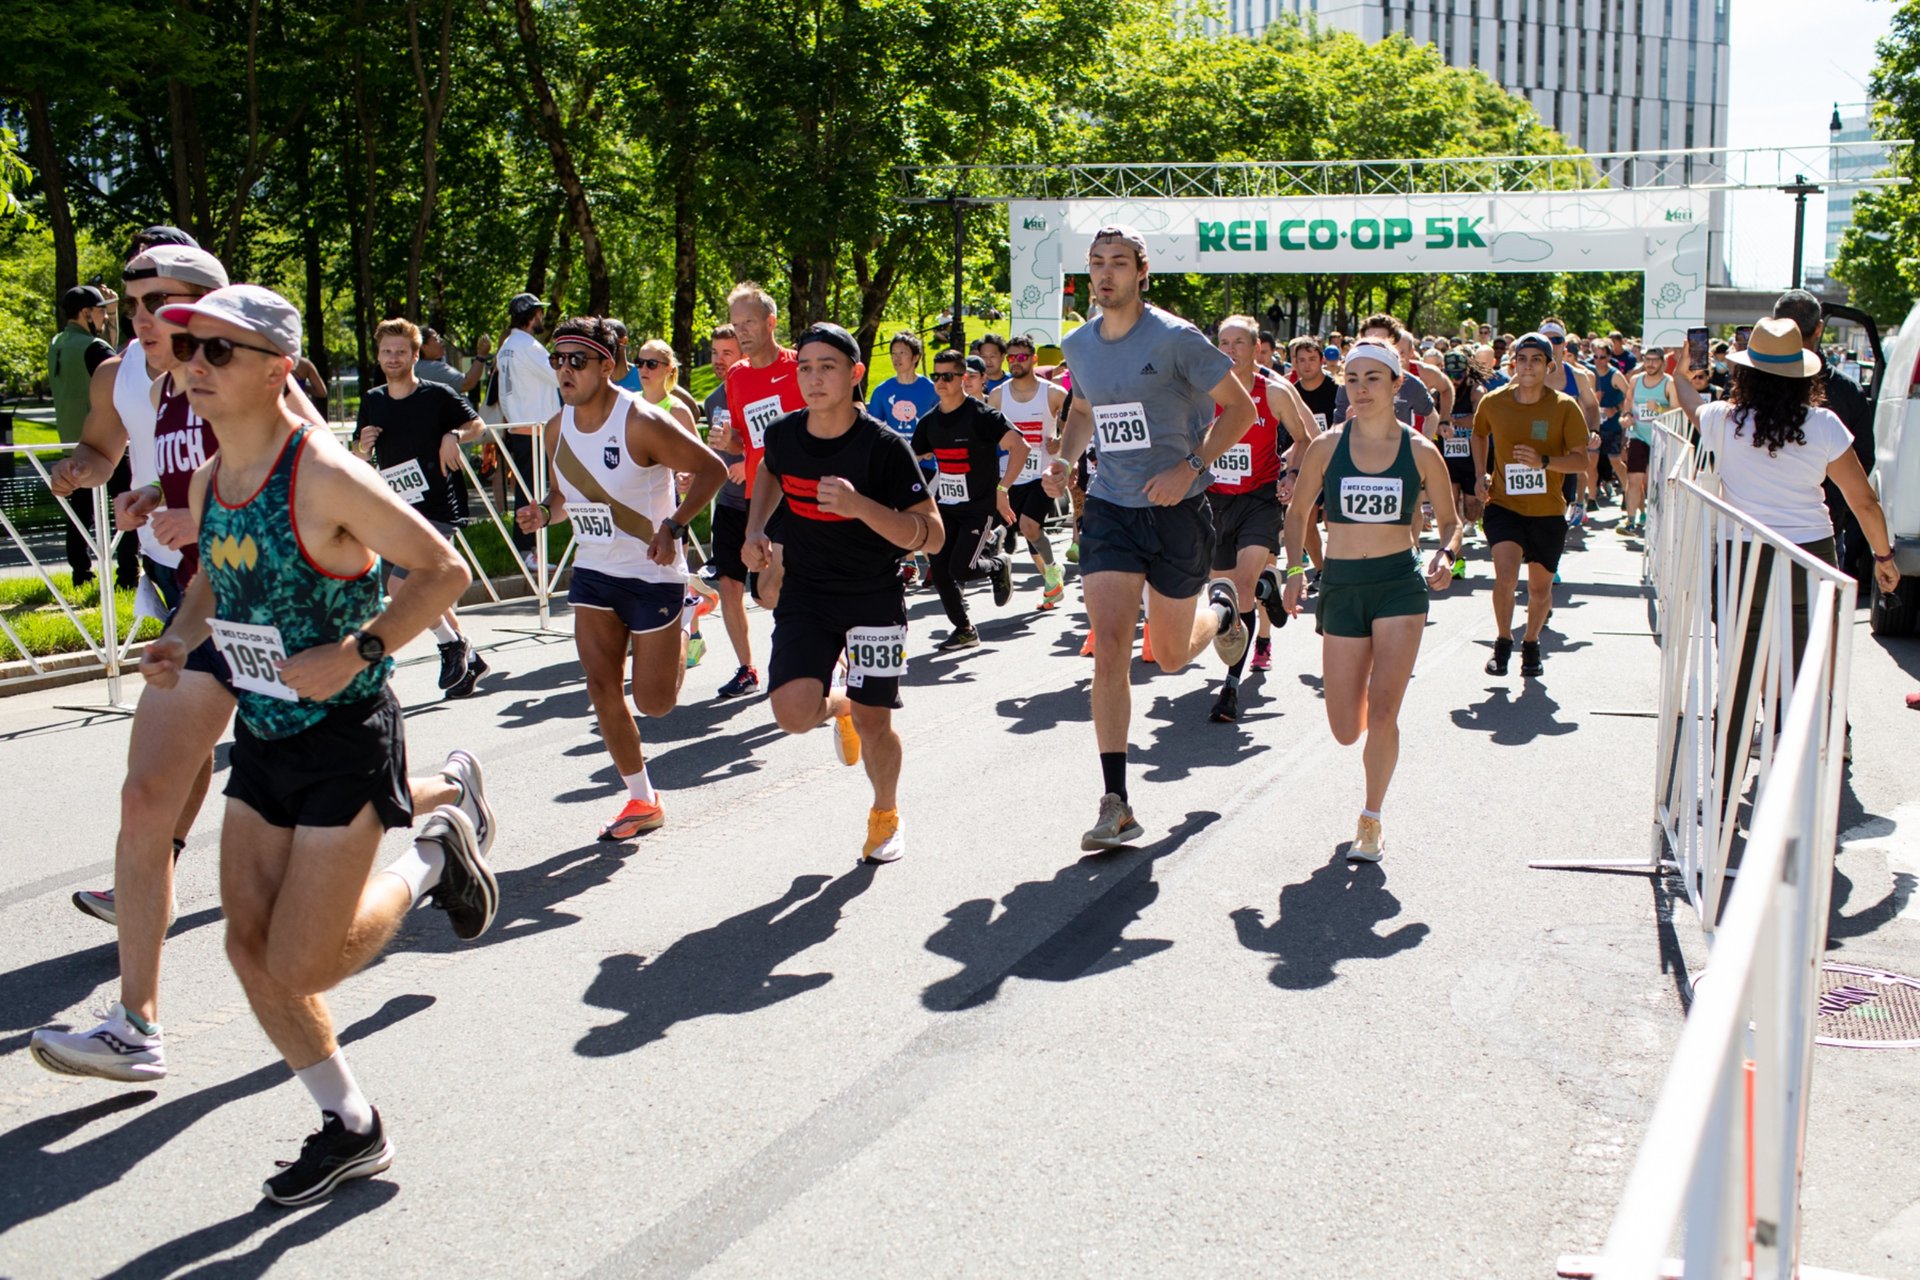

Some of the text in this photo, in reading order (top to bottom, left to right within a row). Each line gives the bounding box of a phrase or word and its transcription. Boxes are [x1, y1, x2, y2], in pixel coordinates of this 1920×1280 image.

[1199, 219, 1268, 252] REI
[1425, 216, 1488, 249] 5K
[1100, 418, 1146, 444] 1239
[1445, 443, 1468, 454] 2190
[388, 471, 424, 494] 2149
[940, 483, 965, 498] 1759
[1508, 473, 1544, 490] 1934
[1343, 493, 1398, 516] 1238
[573, 515, 613, 538] 1454
[850, 643, 904, 669] 1938
